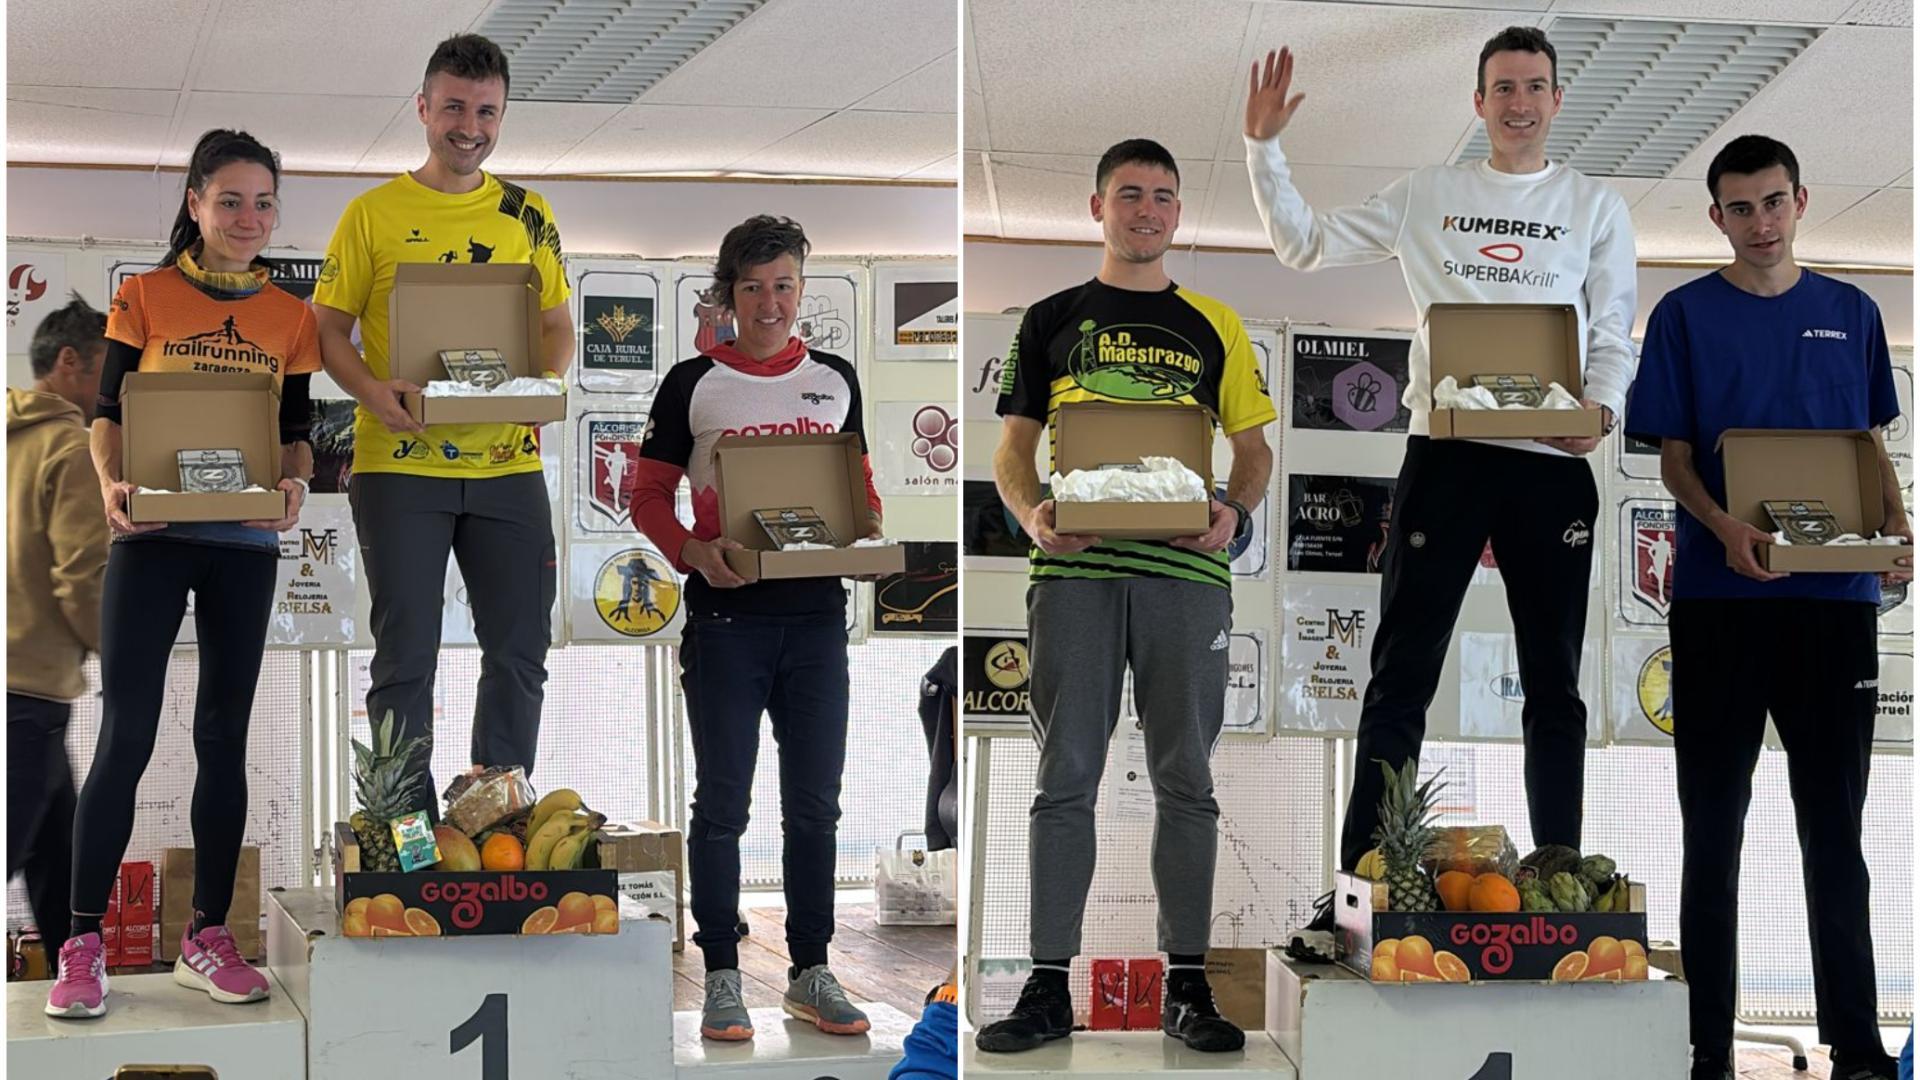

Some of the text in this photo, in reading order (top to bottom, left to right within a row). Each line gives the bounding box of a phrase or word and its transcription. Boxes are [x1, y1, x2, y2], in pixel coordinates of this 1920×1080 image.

[1442, 215, 1558, 241] KUMBREX
[1099, 332, 1137, 346] A.D.
[1813, 329, 1847, 340] TERREX
[587, 344, 650, 354] CAJA RURAL
[1296, 339, 1370, 357] OLMIEL
[163, 340, 279, 374] trailrunning
[593, 354, 643, 363] DE TERUEL
[1099, 346, 1200, 375] Maestrazgo
[904, 476, 939, 485] salón
[1304, 493, 1326, 503] BAR
[1295, 506, 1340, 520] ACRO
[286, 591, 328, 601] RELOJERIA
[277, 602, 332, 614] BIELSA
[1311, 674, 1354, 685] RELOJERIA
[1301, 686, 1358, 700] BIELSA
[449, 992, 509, 1080] 1
